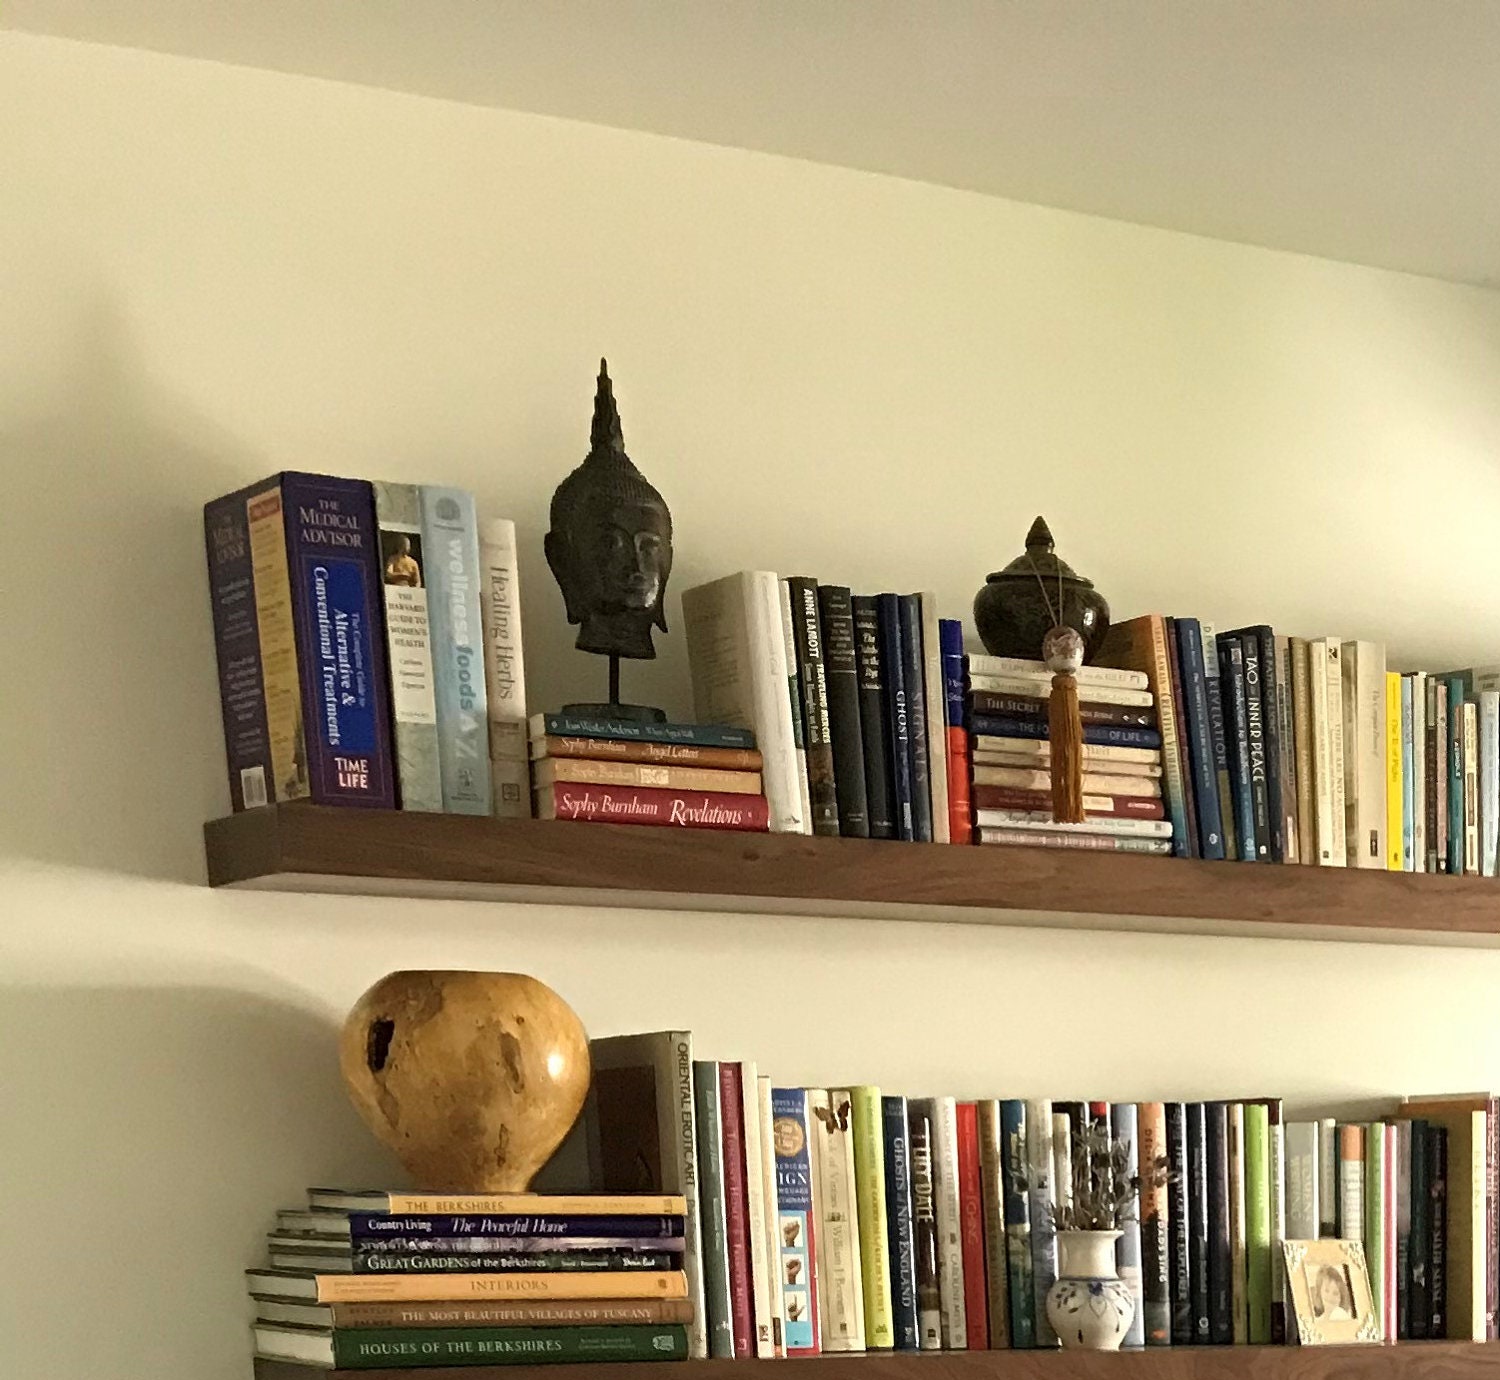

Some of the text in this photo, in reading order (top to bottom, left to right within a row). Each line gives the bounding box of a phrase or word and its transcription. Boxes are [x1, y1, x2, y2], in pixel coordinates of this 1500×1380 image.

[299, 506, 360, 530] MEDICAL
[318, 499, 339, 511] THE
[301, 529, 362, 548] ADVISOR
[490, 566, 515, 700] Healing Herbs
[803, 589, 819, 658] ANNE LAMOTT
[313, 566, 341, 745] Conventional Treatments
[333, 609, 351, 688] Alternative
[1246, 657, 1258, 685] TAO
[895, 691, 908, 743] GHOST
[1007, 700, 1040, 712] SECRET
[913, 692, 926, 782] SIGNALS
[1109, 731, 1140, 741] OF LIFE
[1209, 681, 1226, 765] REVELATION
[1248, 697, 1265, 782] INNER PEACE
[334, 757, 368, 773] TIME
[339, 772, 368, 789] LIFE
[560, 793, 742, 826] Sophy Burnham Revelations
[677, 1042, 691, 1108] ORIENTAL
[681, 1112, 692, 1155] EROTIC
[684, 1158, 695, 1186] ART
[406, 1201, 504, 1212] THE BERKSHIRES
[368, 1220, 432, 1233] Country Living
[451, 1217, 568, 1235] The Peaceful Home
[893, 1137, 910, 1306] GHOSTS NEW ENGLAND
[832, 1226, 845, 1266] William
[368, 1255, 408, 1270] GREAT
[410, 1255, 469, 1269] GARDENS
[470, 1258, 481, 1269] of
[483, 1258, 498, 1268] the
[471, 1280, 548, 1292] INTERIORS
[401, 1310, 424, 1321] THE
[430, 1310, 460, 1321] MOST
[464, 1309, 523, 1321] BEAUTIFUL
[528, 1309, 582, 1319] VILLAGES
[584, 1309, 597, 1319] OF
[600, 1308, 652, 1318] TUSCANY
[360, 1340, 562, 1355] HOUSES OF THE BERKSHIRES
